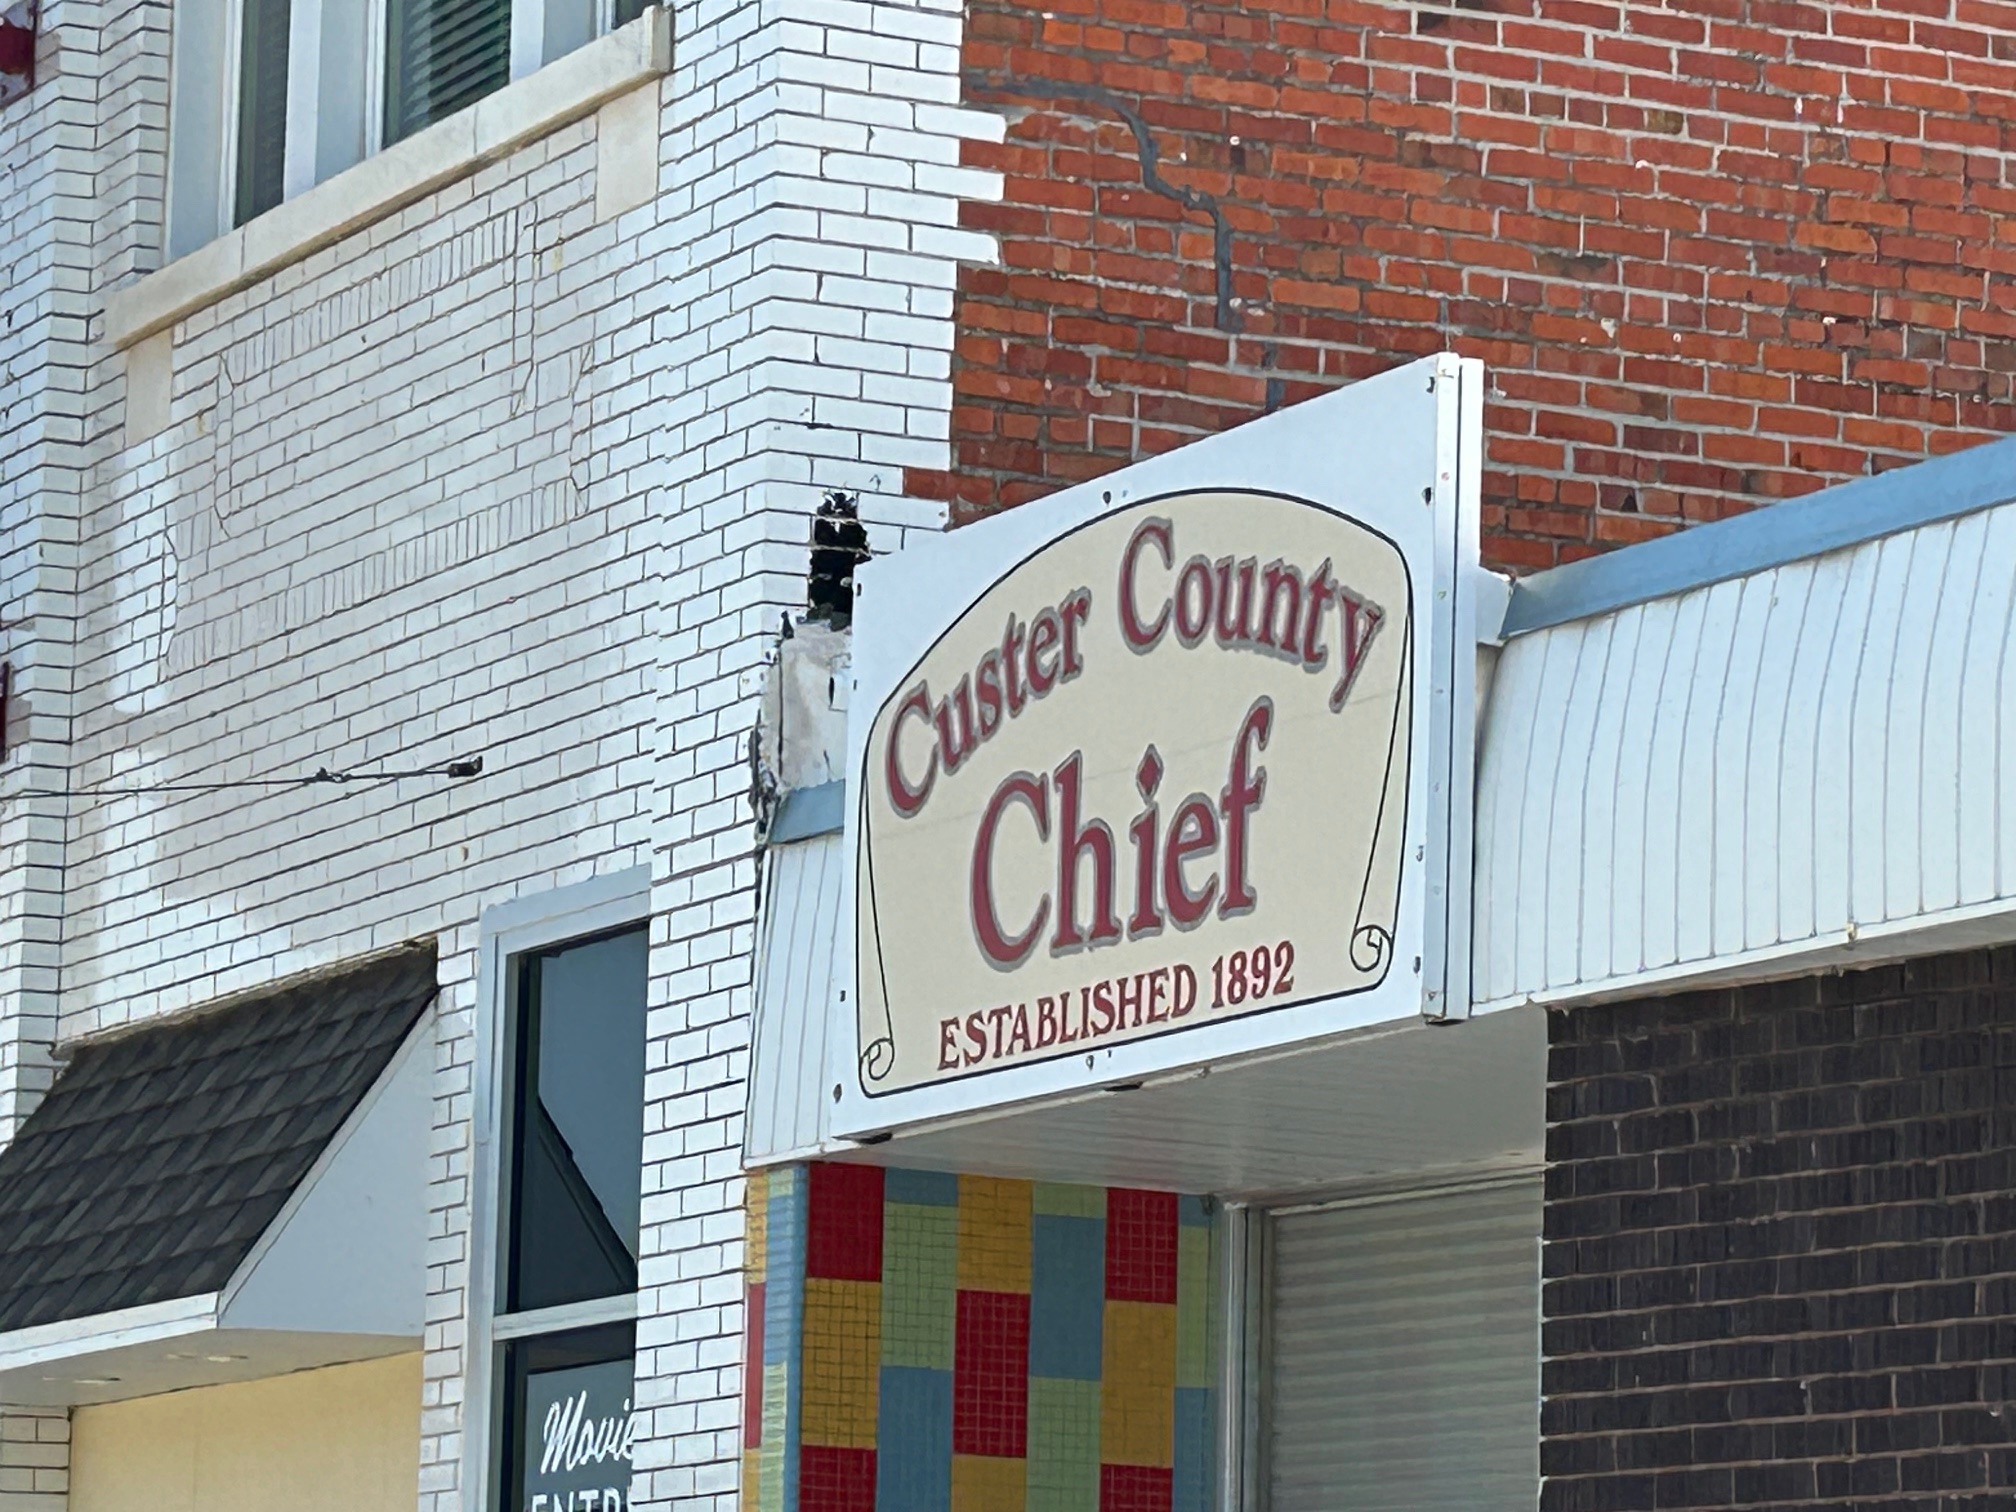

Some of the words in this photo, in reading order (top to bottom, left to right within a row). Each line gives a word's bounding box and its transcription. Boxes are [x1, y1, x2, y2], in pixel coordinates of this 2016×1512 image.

[885, 585, 1093, 819] Custer
[1117, 516, 1384, 714] County
[970, 694, 1274, 973] Chief
[937, 963, 1198, 1072] ESTABLISHED
[1211, 941, 1296, 1009] 1892
